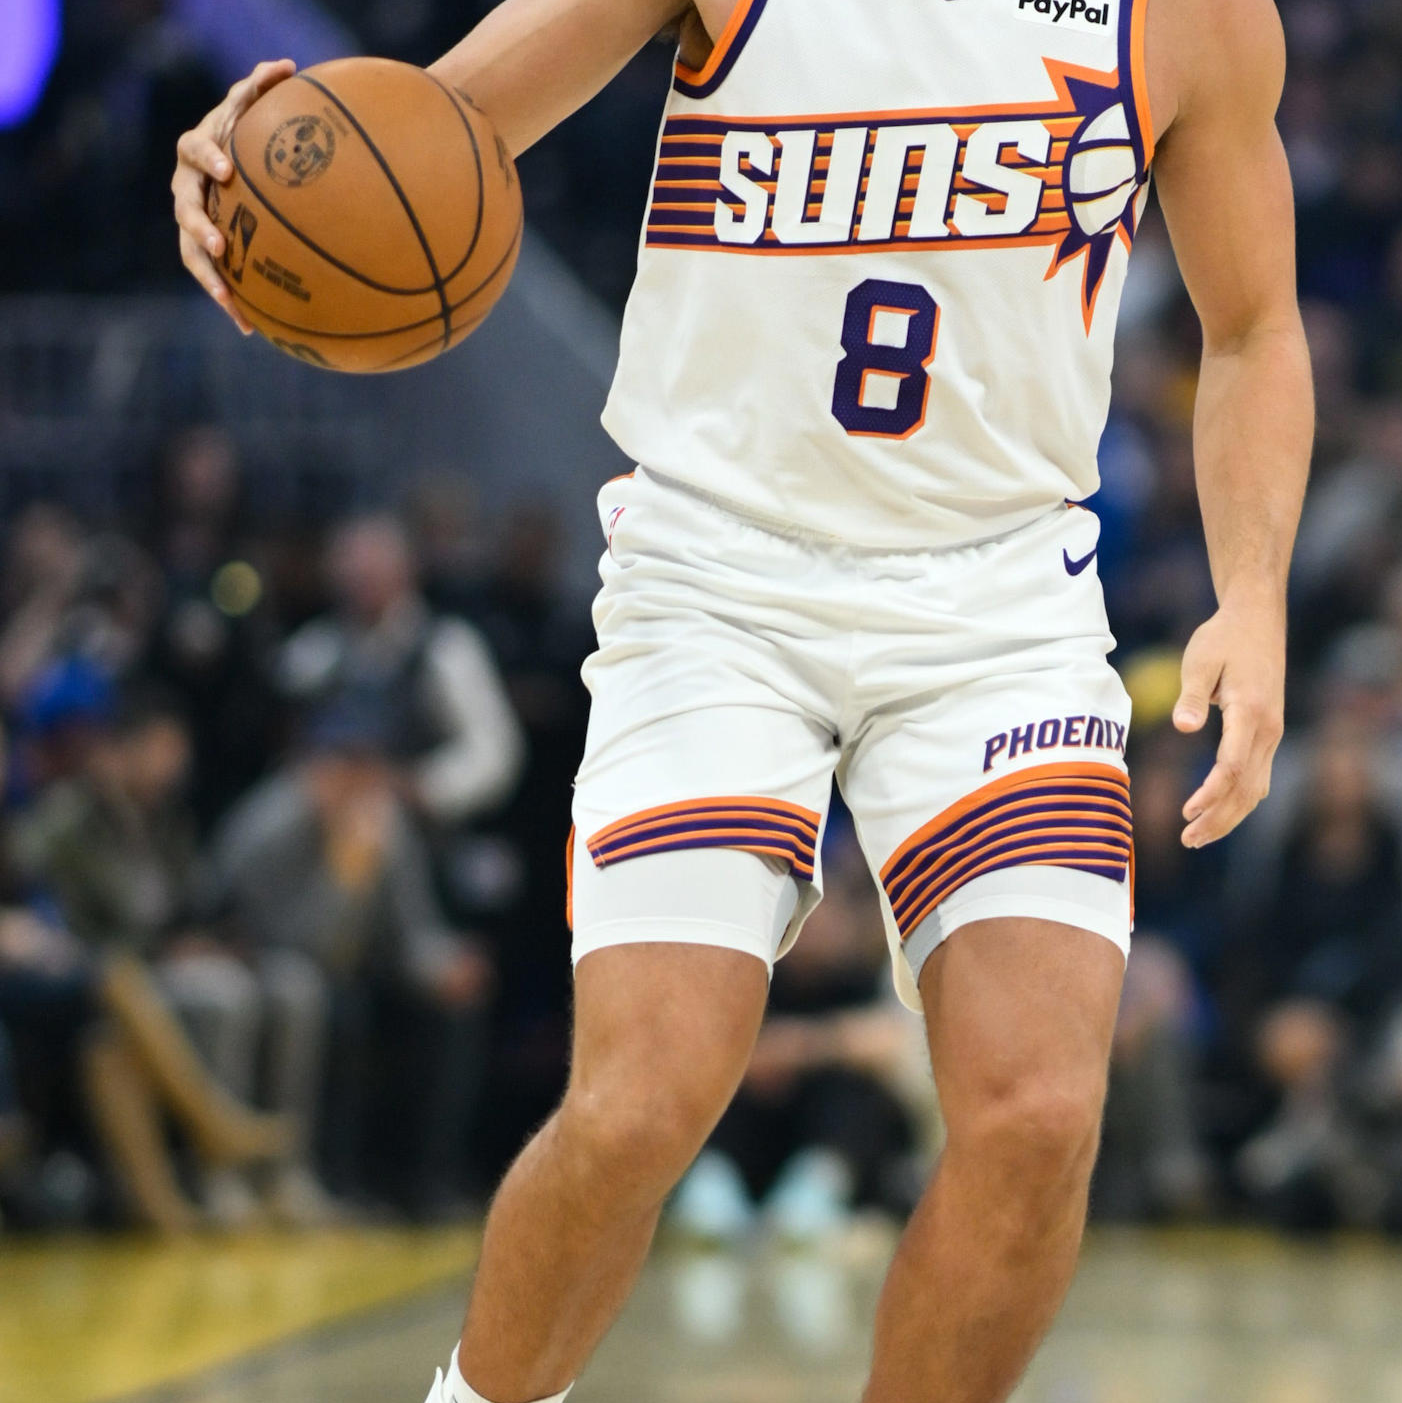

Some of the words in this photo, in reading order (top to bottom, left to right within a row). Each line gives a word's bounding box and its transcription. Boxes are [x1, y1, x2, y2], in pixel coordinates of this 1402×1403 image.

[714, 119, 1048, 246] SUNS
[831, 278, 941, 440] 8
[983, 714, 1127, 774] PHOENIX
